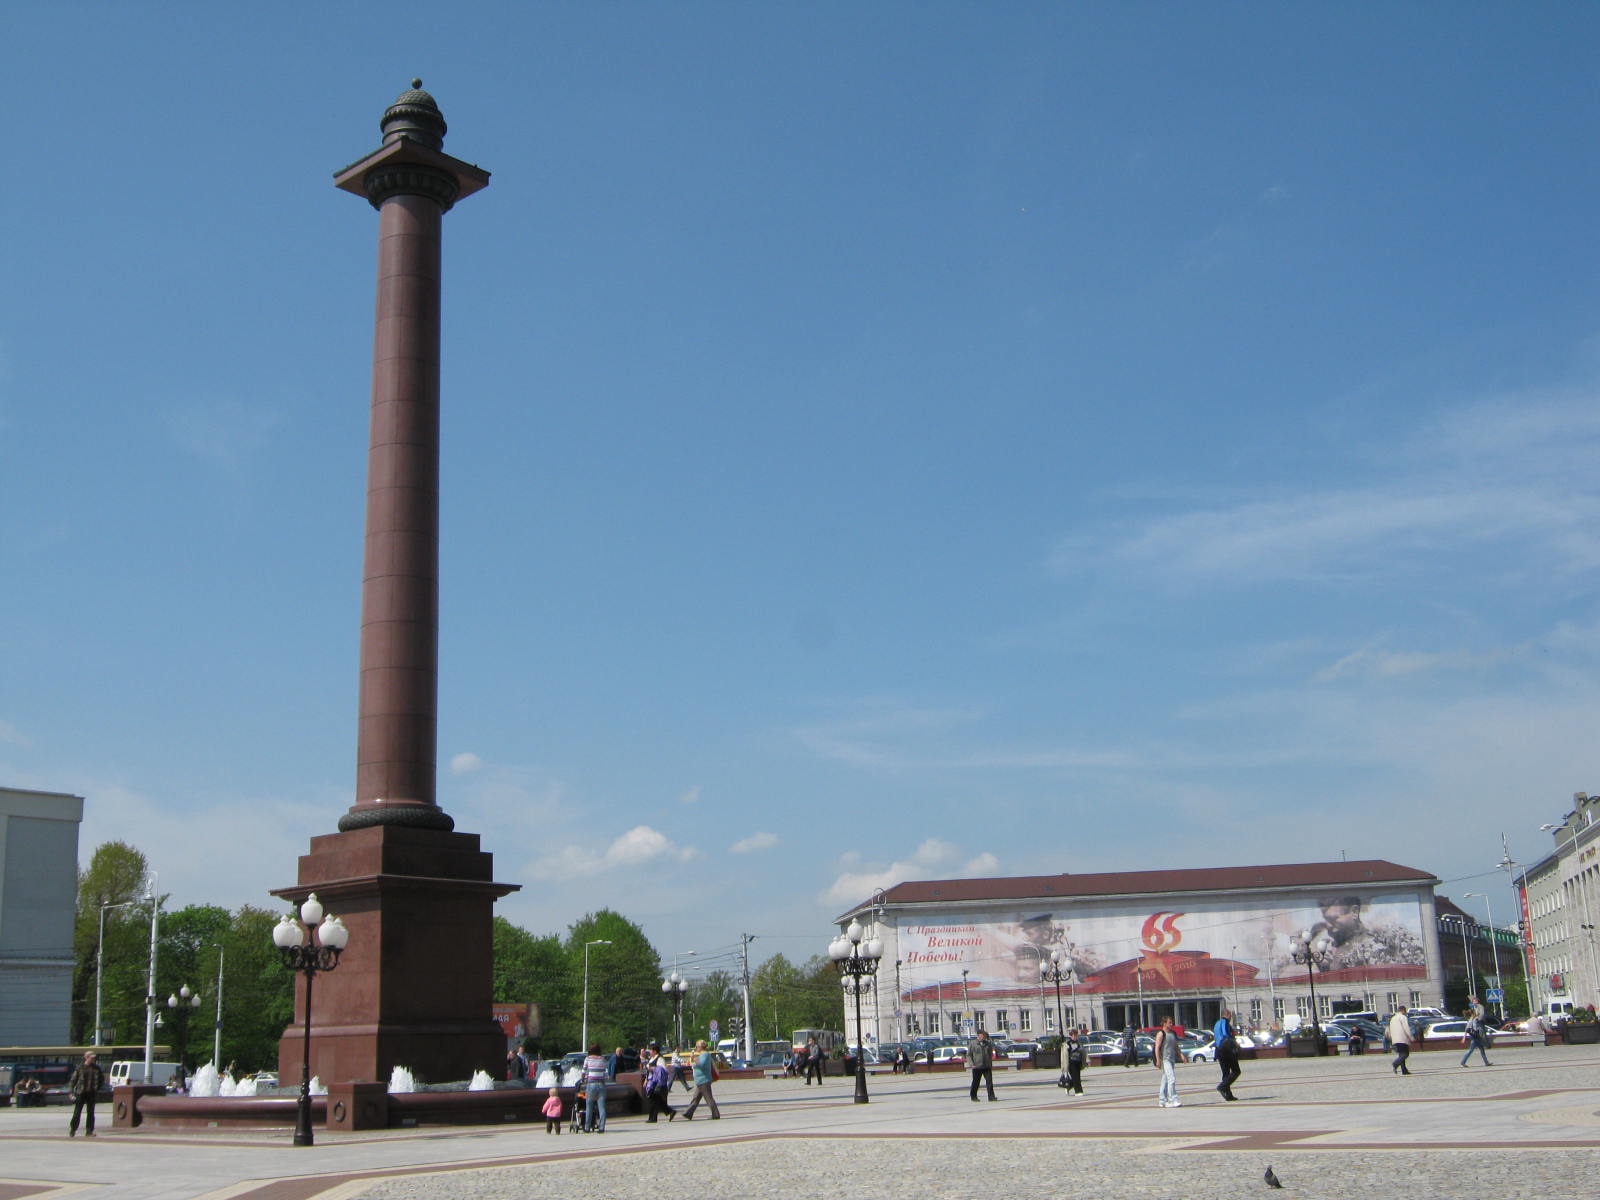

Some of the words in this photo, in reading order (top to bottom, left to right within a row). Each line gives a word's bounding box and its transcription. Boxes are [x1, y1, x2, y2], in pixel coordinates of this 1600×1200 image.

[907, 925, 914, 935] С
[917, 925, 976, 936] Праздником
[928, 935, 983, 948] Великой
[907, 949, 964, 963] Победы!
